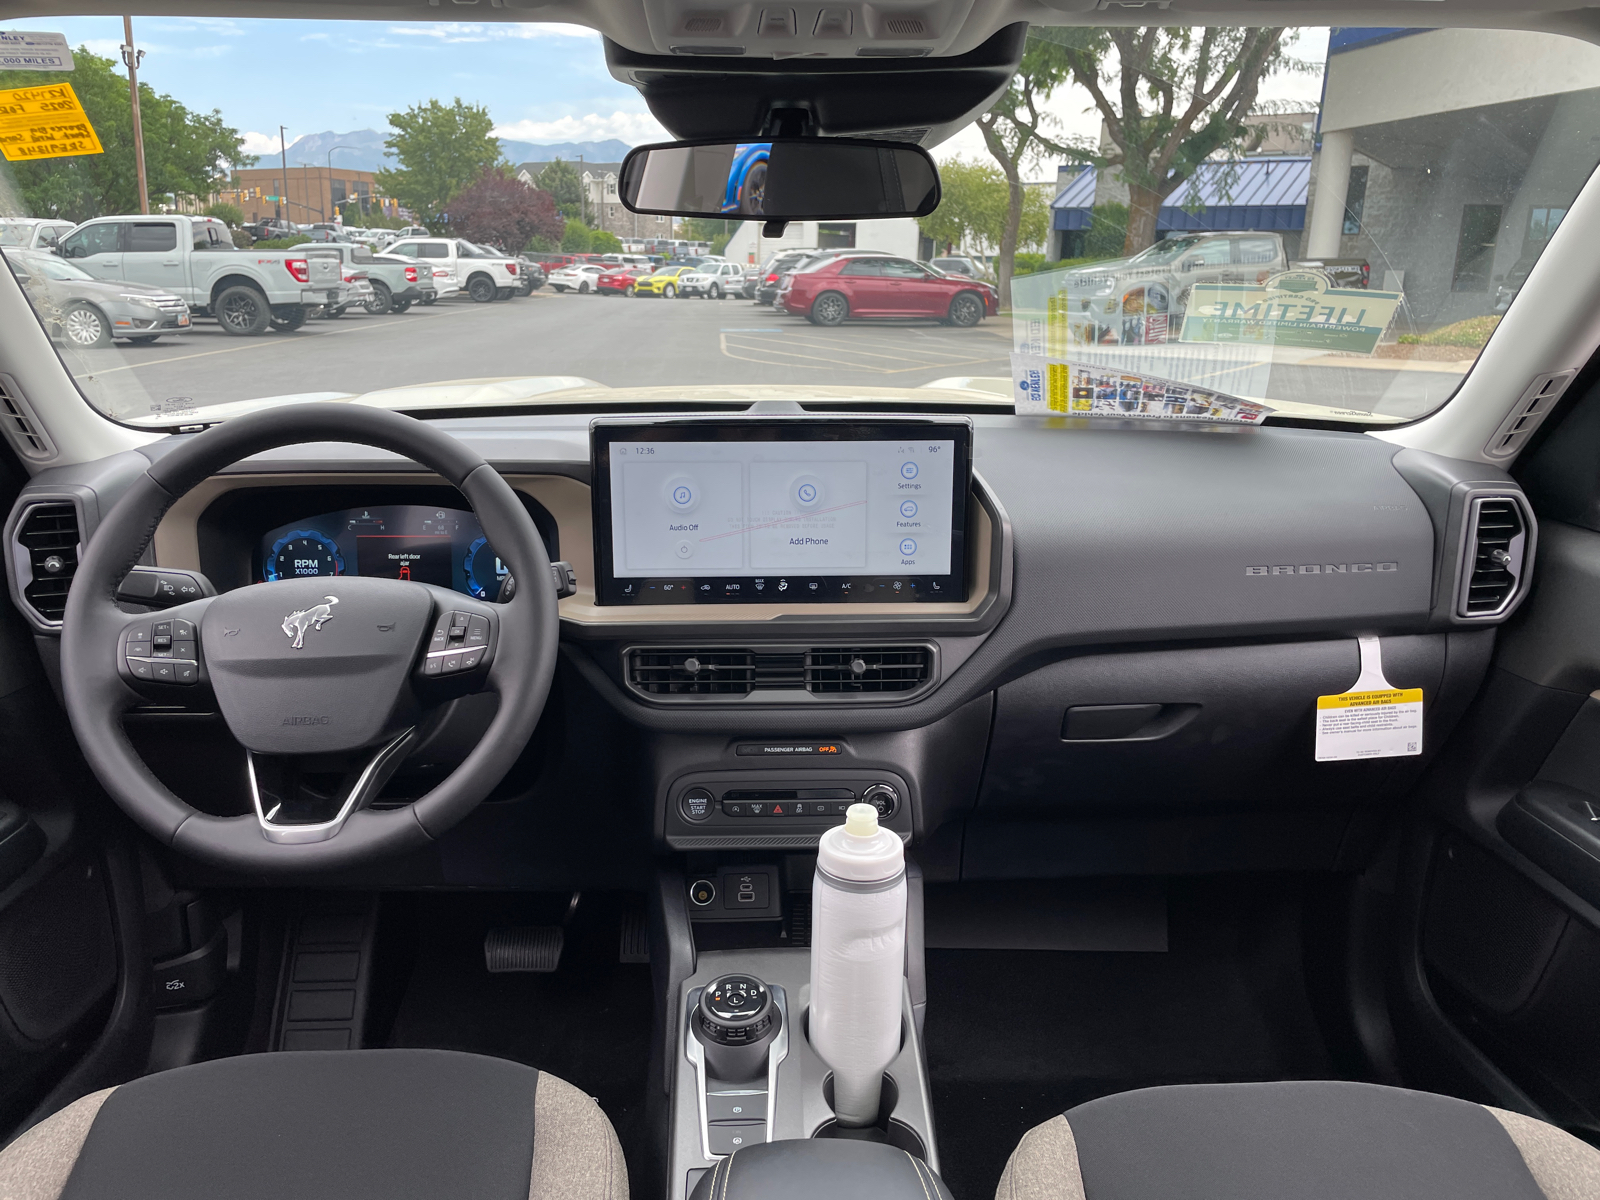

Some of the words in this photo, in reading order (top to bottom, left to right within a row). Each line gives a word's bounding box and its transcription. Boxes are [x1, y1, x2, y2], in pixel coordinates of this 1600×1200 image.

[0, 57, 22, 66] ,000
[897, 482, 922, 491] Settings
[669, 523, 687, 532] Audio
[688, 523, 699, 531] Off
[294, 560, 318, 568] RPM
[901, 558, 916, 566] Apps
[1246, 562, 1398, 576] BRONCO
[282, 716, 329, 726] AIRBAG
